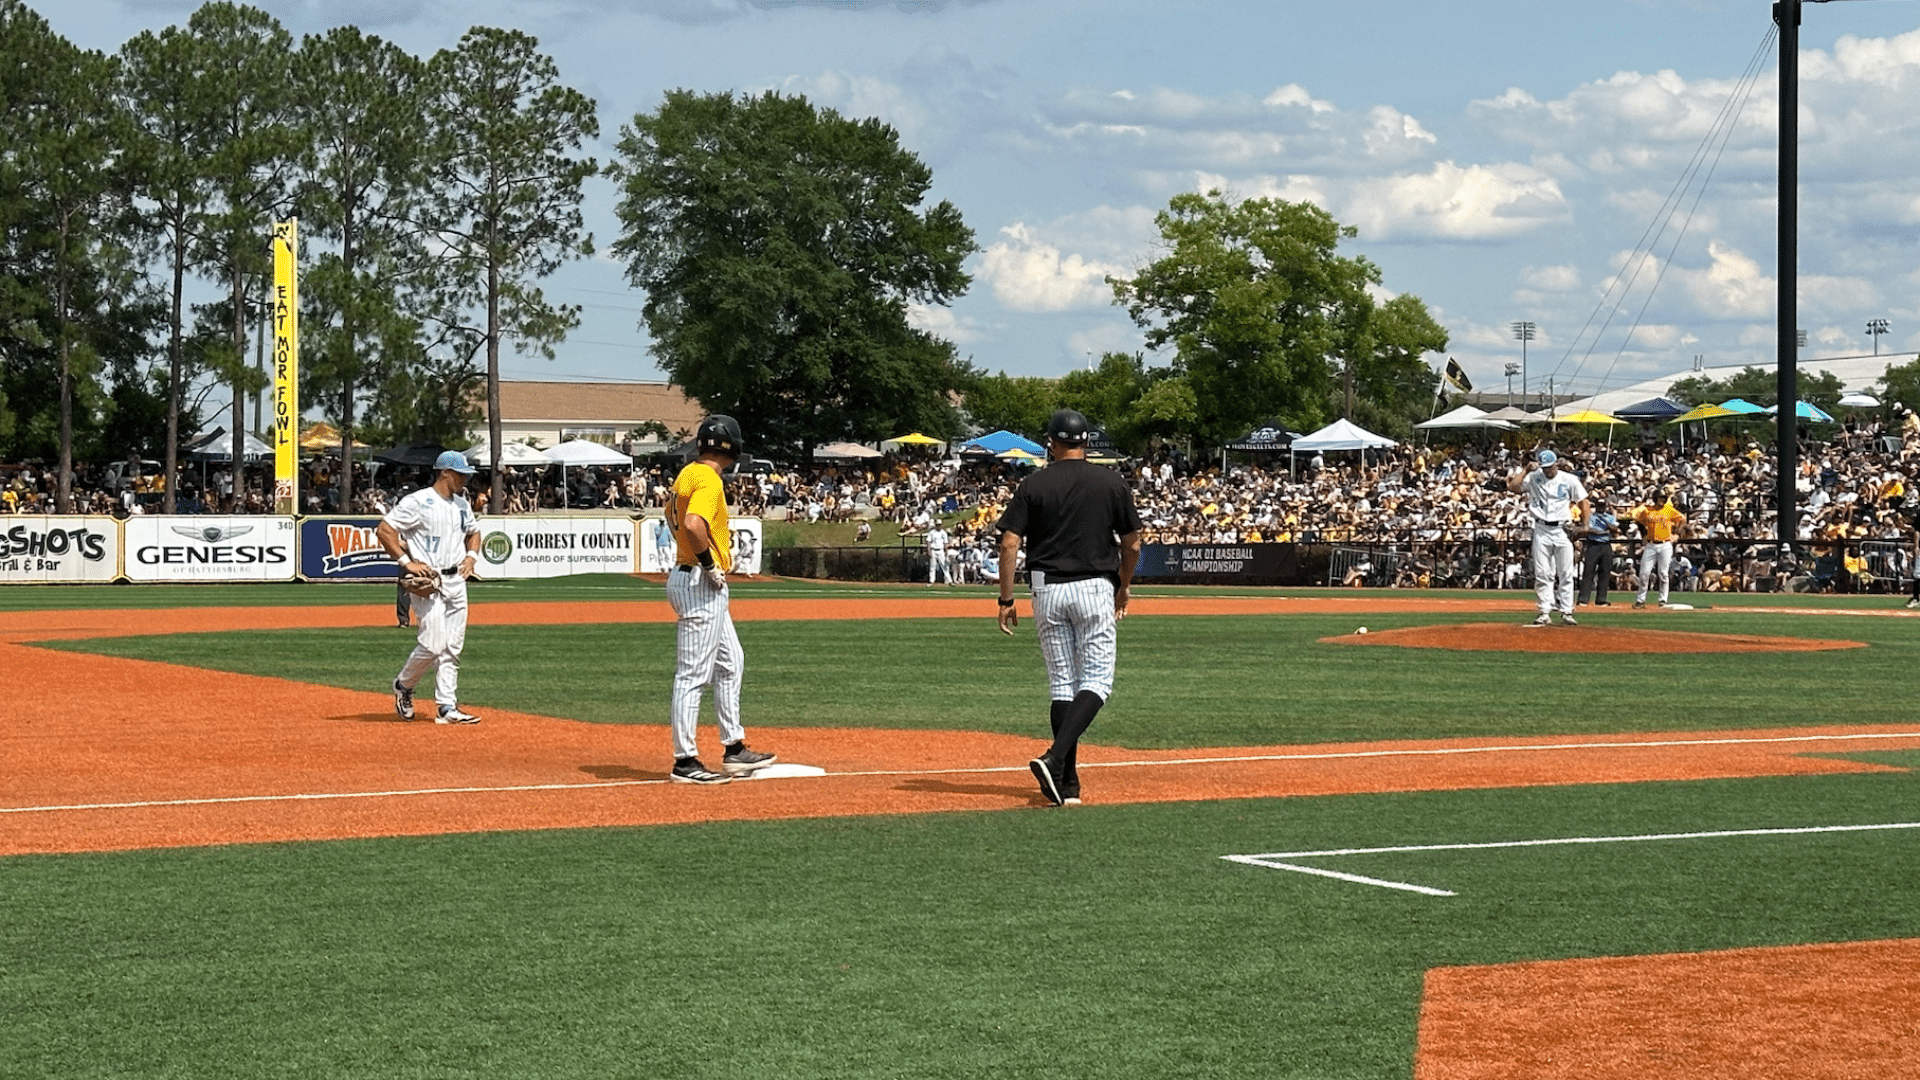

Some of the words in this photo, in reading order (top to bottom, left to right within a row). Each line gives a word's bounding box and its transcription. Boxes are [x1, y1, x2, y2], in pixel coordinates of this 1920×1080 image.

[277, 285, 288, 330] EAT
[277, 336, 289, 381] MOR
[276, 386, 289, 445] FOWL
[278, 521, 293, 530] 340
[425, 536, 440, 553] 17
[516, 533, 576, 549] FORREST
[581, 533, 631, 549] COUNTY
[137, 545, 287, 564] GENESIS
[520, 555, 551, 563] BOARD
[553, 555, 565, 563] OF
[567, 555, 628, 563] SUPERVISORS
[1182, 548, 1201, 560] NCAA
[1215, 548, 1253, 560] BASEBALL
[0, 558, 18, 571] rill
[37, 559, 61, 570] Bar
[1182, 560, 1244, 573] CHAMPIONSHIP
